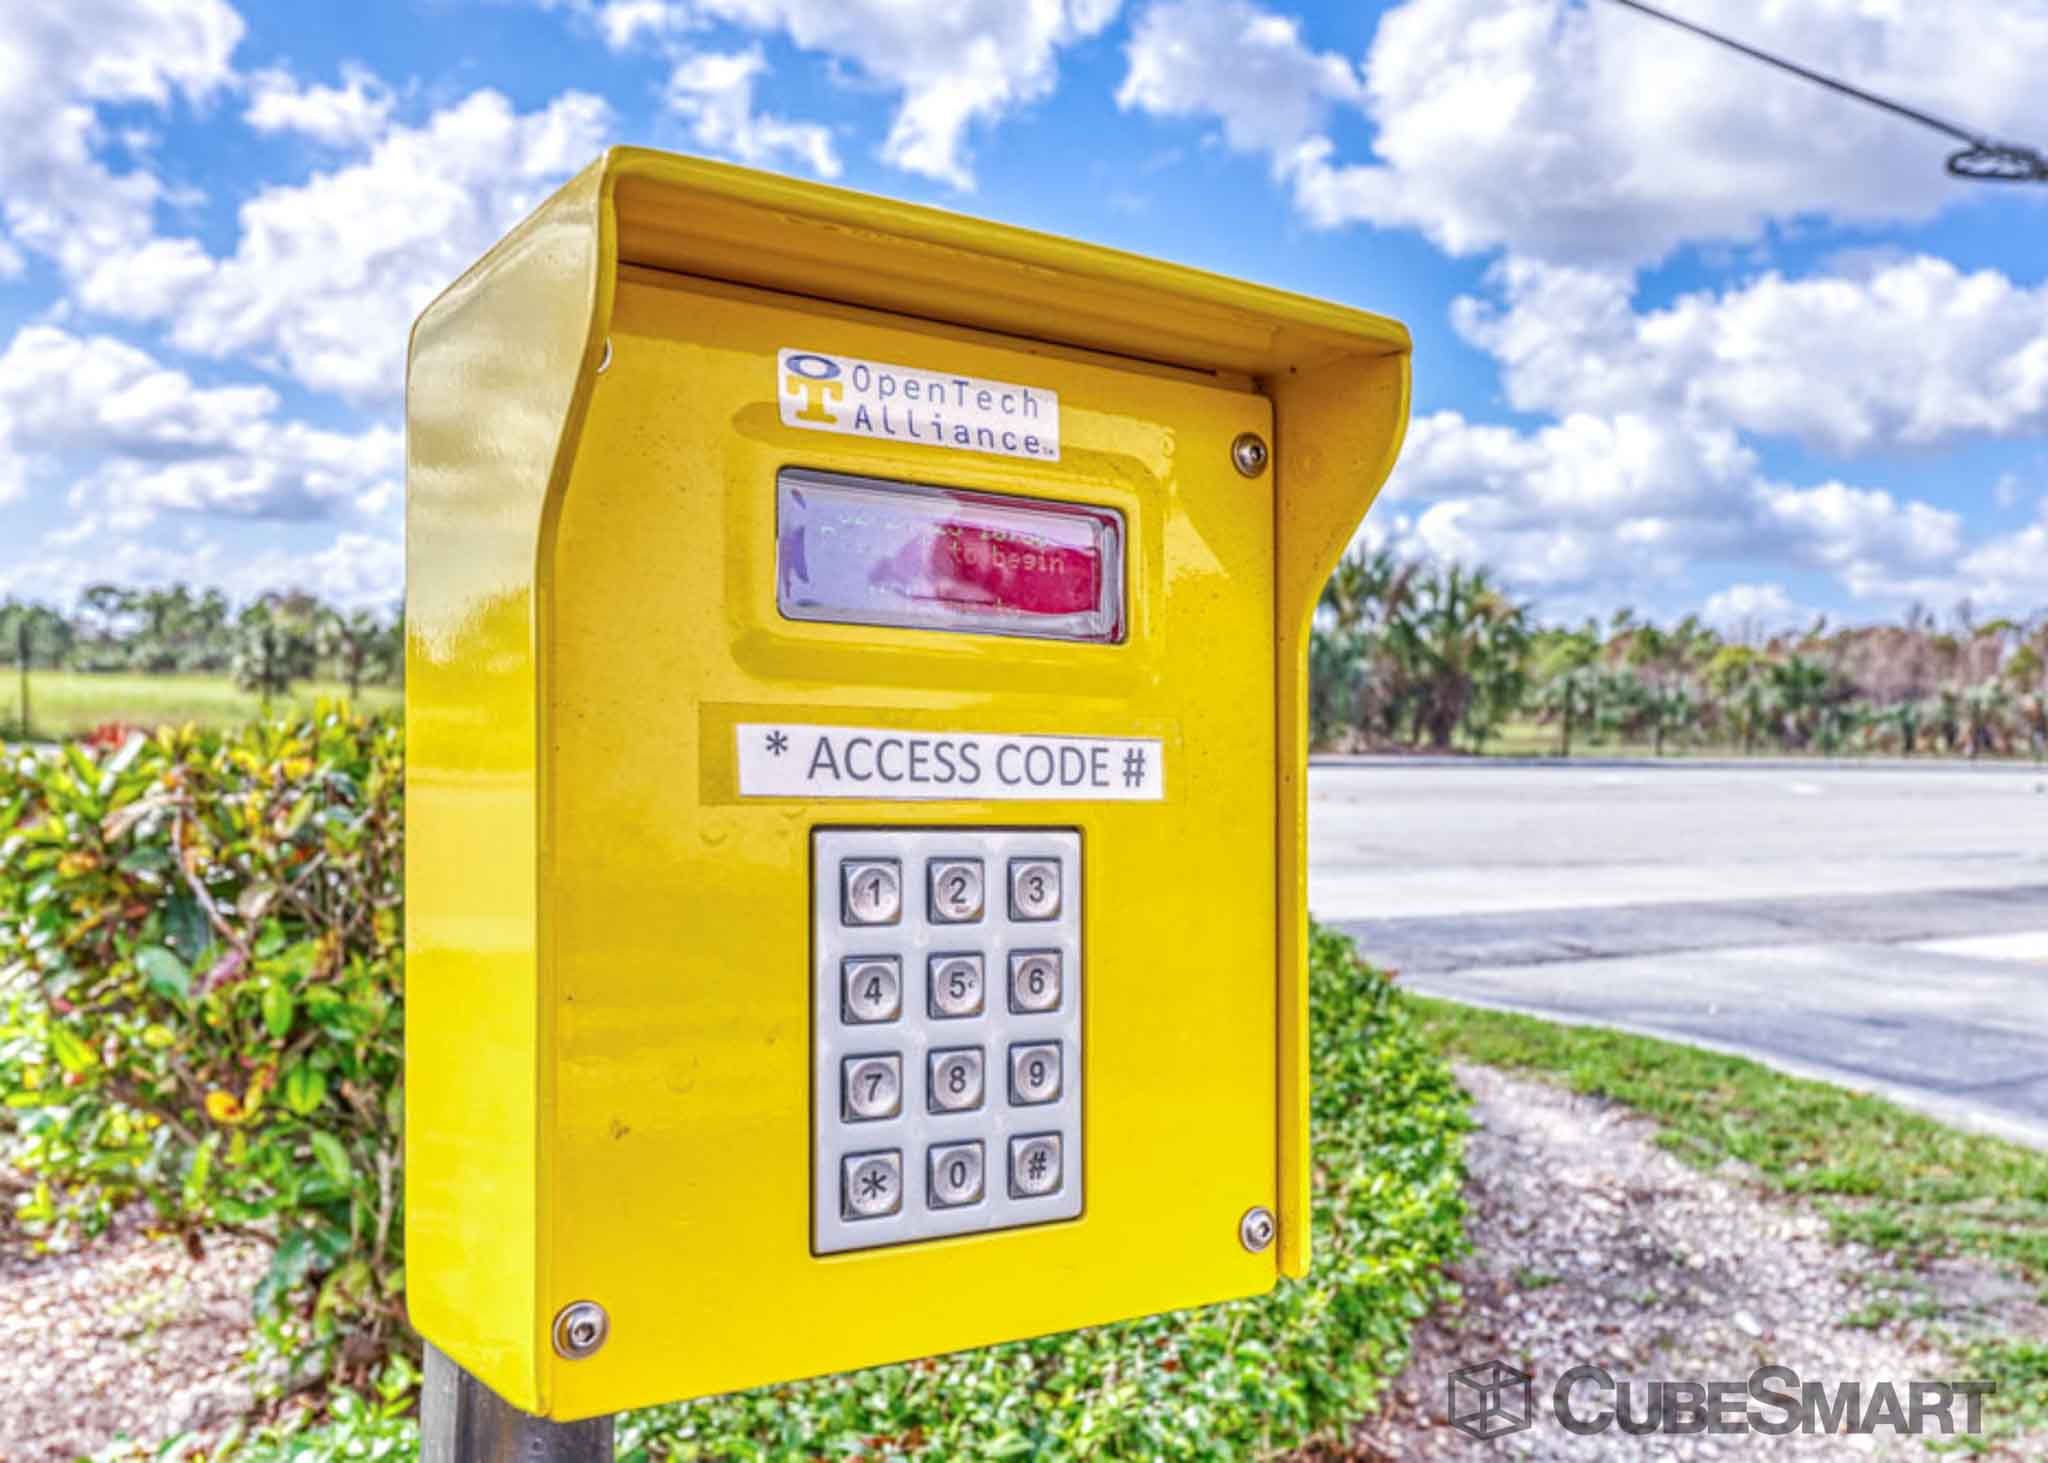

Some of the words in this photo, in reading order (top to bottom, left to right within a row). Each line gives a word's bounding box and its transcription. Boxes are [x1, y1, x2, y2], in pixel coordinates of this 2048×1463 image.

[852, 365, 1039, 419] OpenTech
[855, 404, 1041, 455] Alliance
[807, 735, 981, 784] ACCESS
[996, 744, 1110, 787] CODE
[1122, 747, 1146, 788] #
[867, 878, 881, 907] 1
[949, 877, 967, 905] 2
[1028, 876, 1045, 903] 3
[863, 976, 883, 1005] 4
[949, 971, 966, 999] 5
[1028, 968, 1045, 995] 6
[864, 1073, 883, 1102] 7
[949, 1065, 967, 1094] 8
[1029, 1060, 1045, 1087] 9
[950, 1161, 967, 1189] 0
[1028, 1151, 1047, 1180] #
